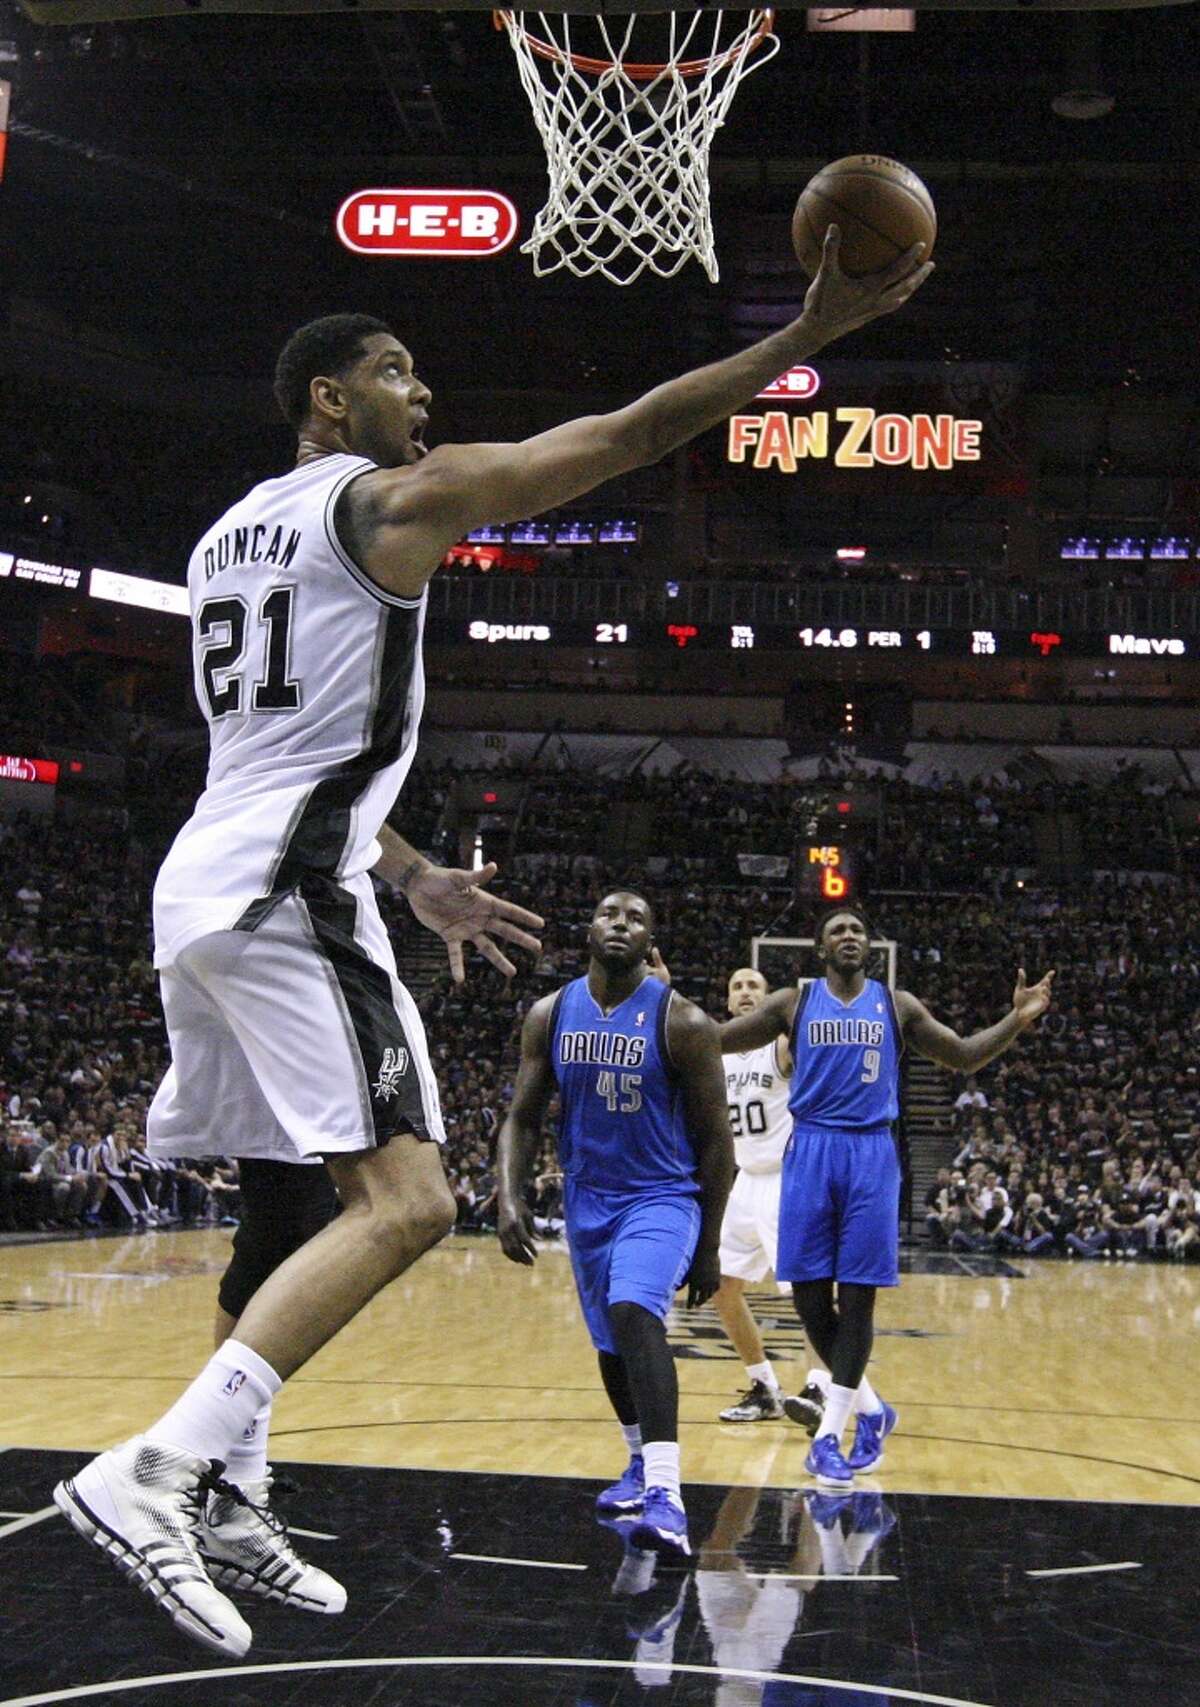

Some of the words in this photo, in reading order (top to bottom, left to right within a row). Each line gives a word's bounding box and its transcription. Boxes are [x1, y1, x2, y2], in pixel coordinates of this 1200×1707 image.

[358, 204, 499, 238] H-E-B
[728, 411, 828, 473] FAN
[835, 407, 982, 470] ZONE
[204, 523, 302, 582] DUNCAN
[469, 621, 550, 642] Spurs
[596, 624, 627, 642] 21
[800, 628, 857, 648] 14.6
[868, 631, 901, 647] PER
[917, 631, 930, 649] 1
[1110, 635, 1185, 655] Mavs
[198, 583, 304, 721] 21
[560, 1031, 646, 1067] DALLAS
[808, 1018, 884, 1048] DALLAS
[727, 1071, 774, 1089] PURS
[861, 1049, 881, 1084] 9
[596, 1070, 642, 1113] 45
[728, 1100, 767, 1137] 20
